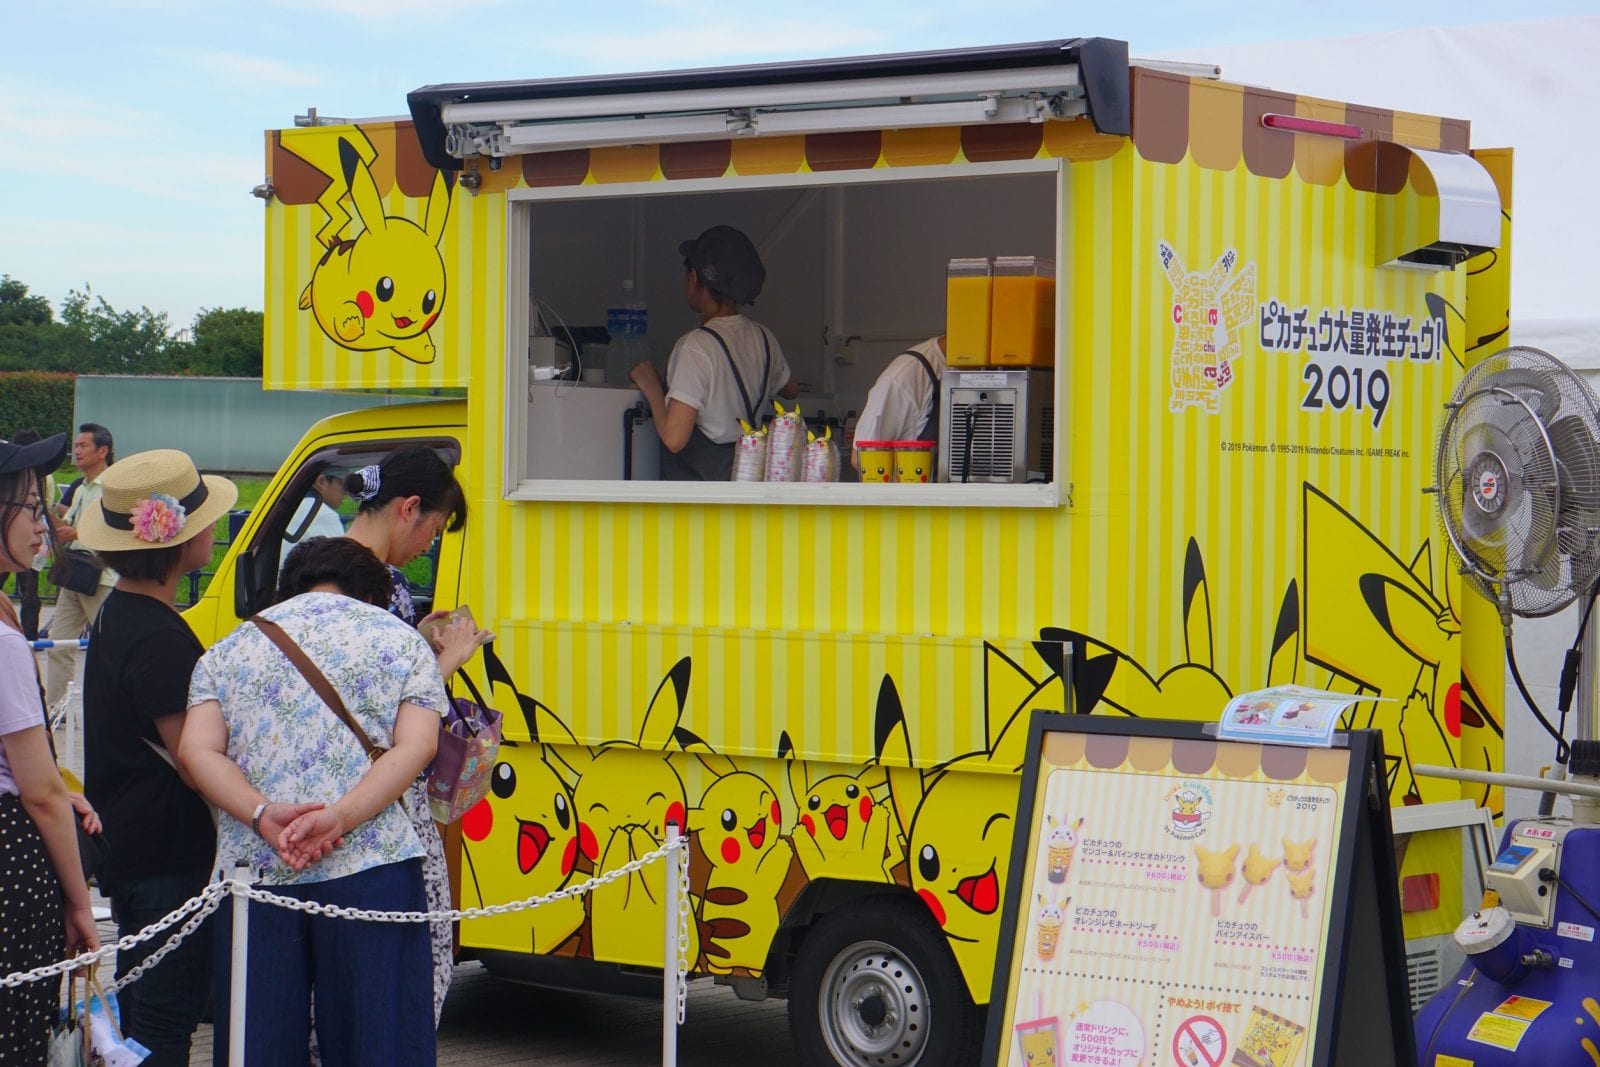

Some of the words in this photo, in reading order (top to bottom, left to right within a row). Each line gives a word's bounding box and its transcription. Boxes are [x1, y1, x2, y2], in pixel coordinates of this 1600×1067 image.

[1260, 300, 1443, 360] ピカチュウ大量発生チュウ!
[1302, 363, 1390, 428] 2019
[1228, 442, 1241, 451] 2019
[1385, 448, 1401, 458] FREAK
[1296, 802, 1317, 812] 2019
